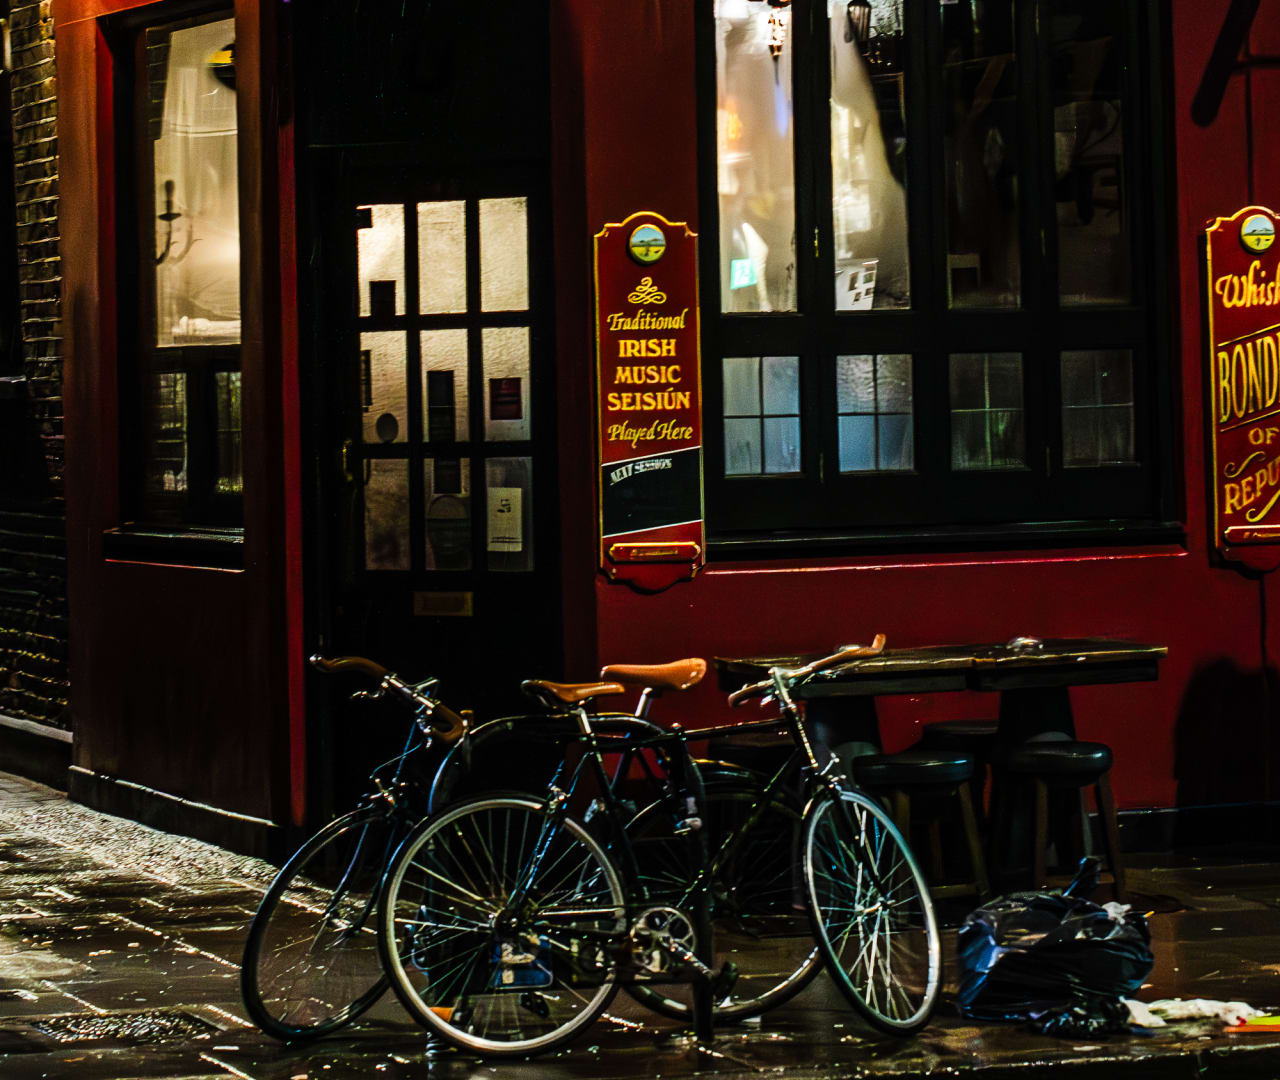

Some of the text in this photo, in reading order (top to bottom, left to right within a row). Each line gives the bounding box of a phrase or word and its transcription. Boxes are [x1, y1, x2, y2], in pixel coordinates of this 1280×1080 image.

[607, 307, 688, 332] Traditional
[618, 339, 677, 358] IRISH
[614, 366, 682, 384] MUSIC
[608, 387, 691, 411] SEISIÚN
[608, 419, 693, 449] Played Here
[1248, 427, 1280, 446] OF
